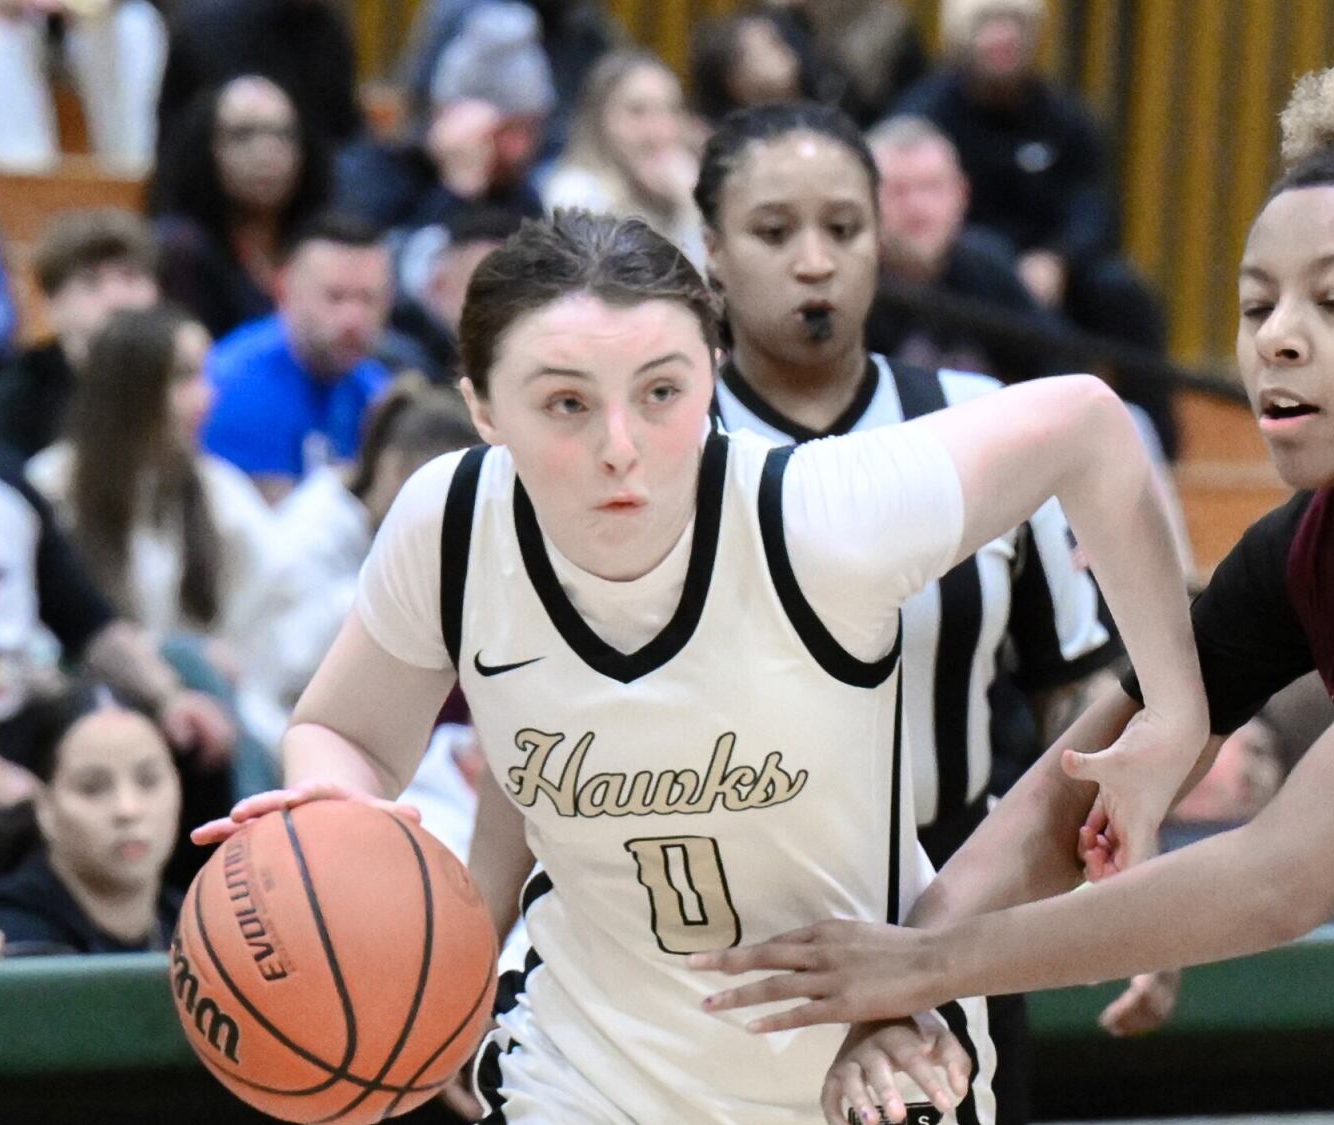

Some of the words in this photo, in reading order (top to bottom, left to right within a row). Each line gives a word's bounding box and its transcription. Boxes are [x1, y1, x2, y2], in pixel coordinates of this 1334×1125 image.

[505, 727, 809, 818] Hawks
[223, 832, 288, 982] EVOLUTIO
[623, 834, 742, 956] 0
